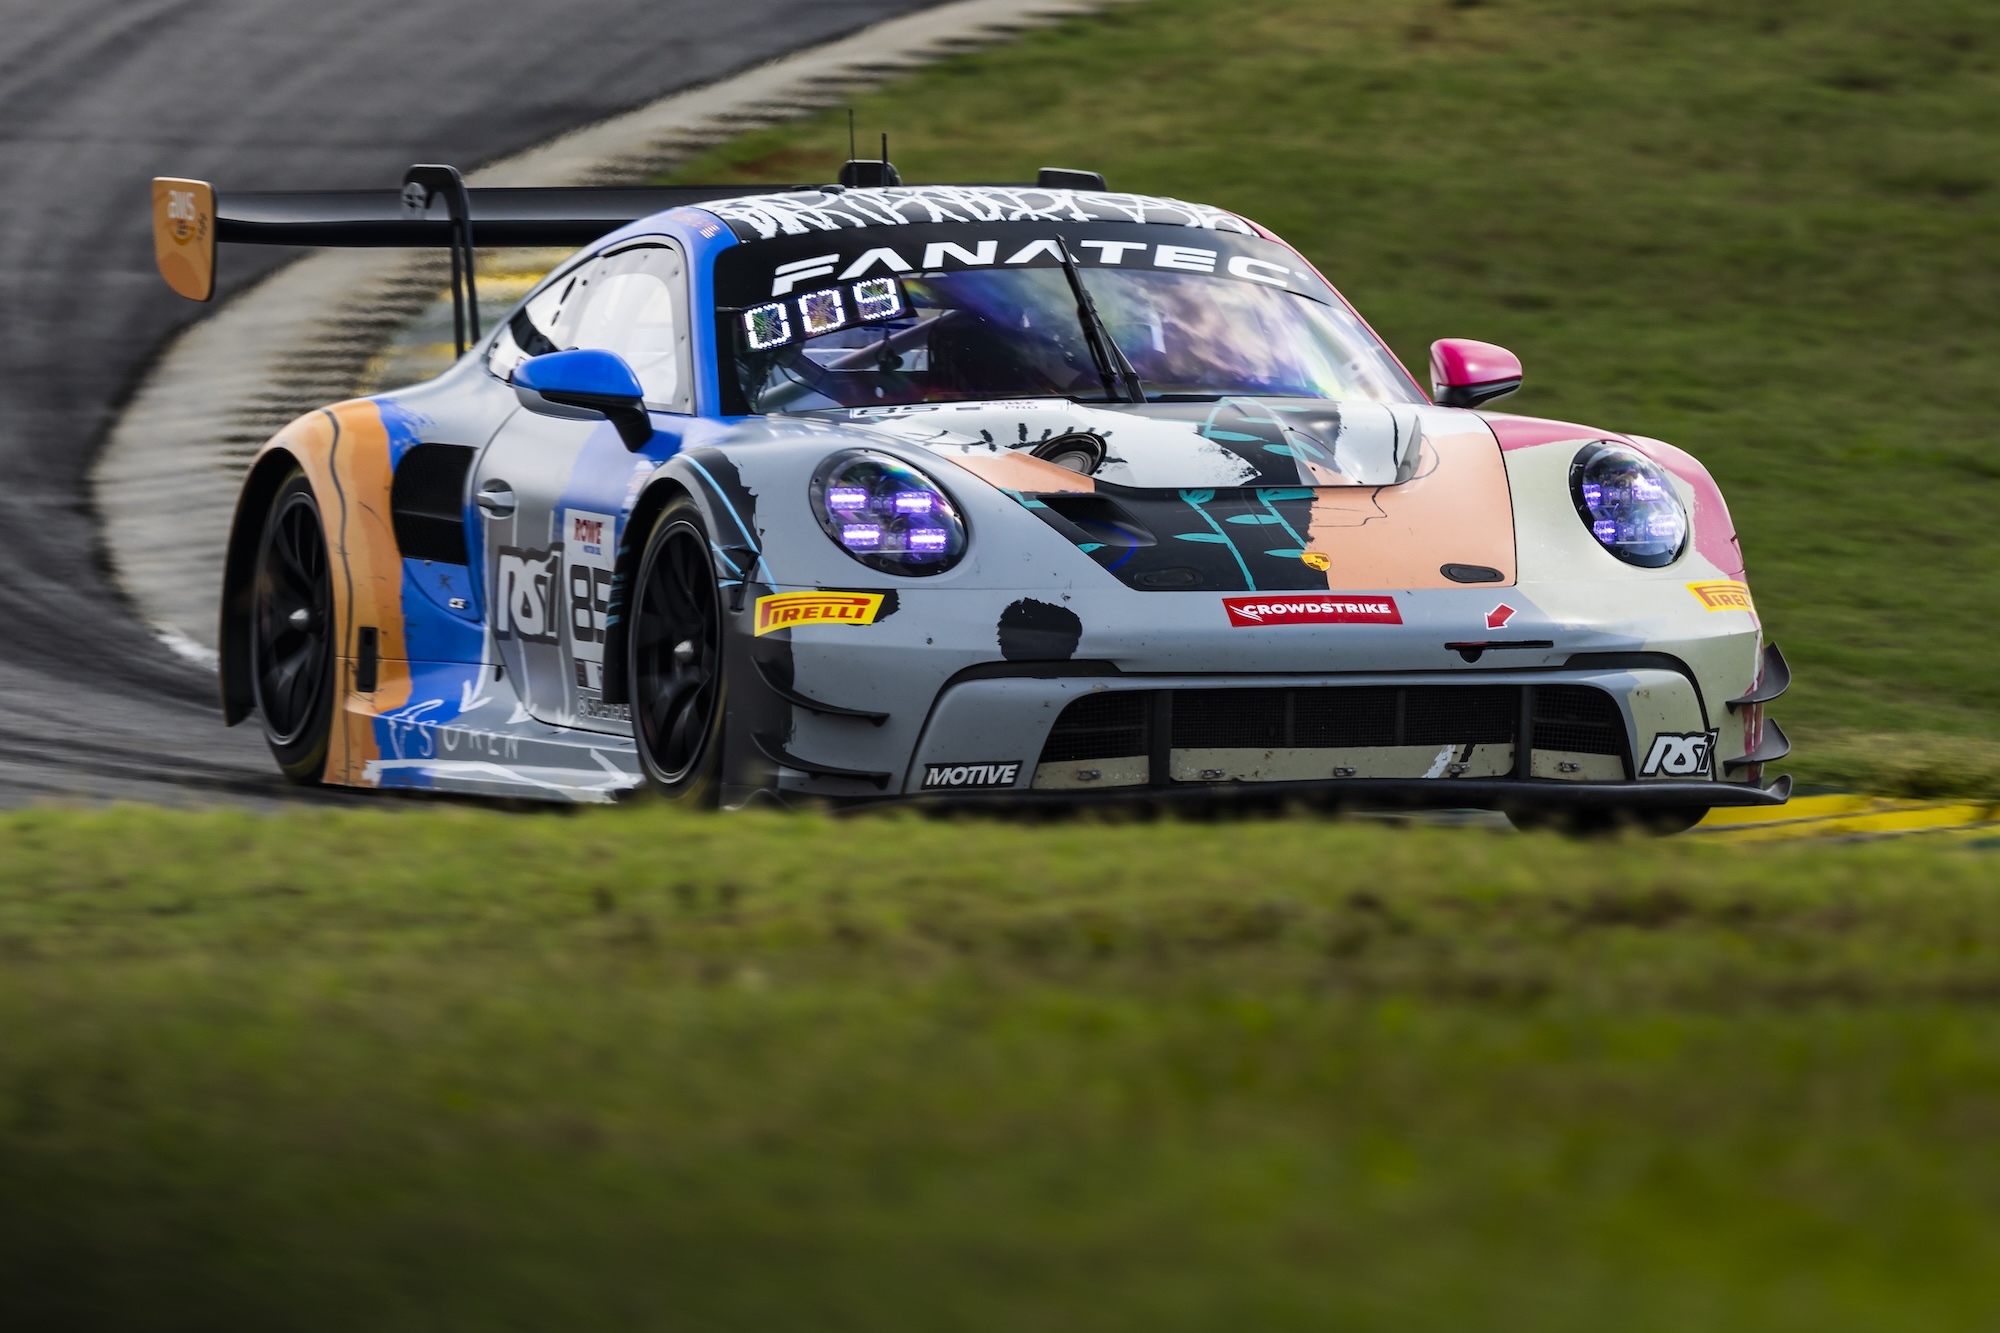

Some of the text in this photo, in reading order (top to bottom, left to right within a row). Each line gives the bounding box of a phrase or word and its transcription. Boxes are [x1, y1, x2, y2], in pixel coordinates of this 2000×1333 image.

[771, 240, 1290, 297] FANATEC
[574, 518, 604, 544] ROWE
[1694, 584, 1752, 607] PIREL
[760, 596, 870, 628] PIRELLI
[1242, 603, 1391, 615] CROWDSTRIKE
[926, 764, 1018, 785] MOTIVE
